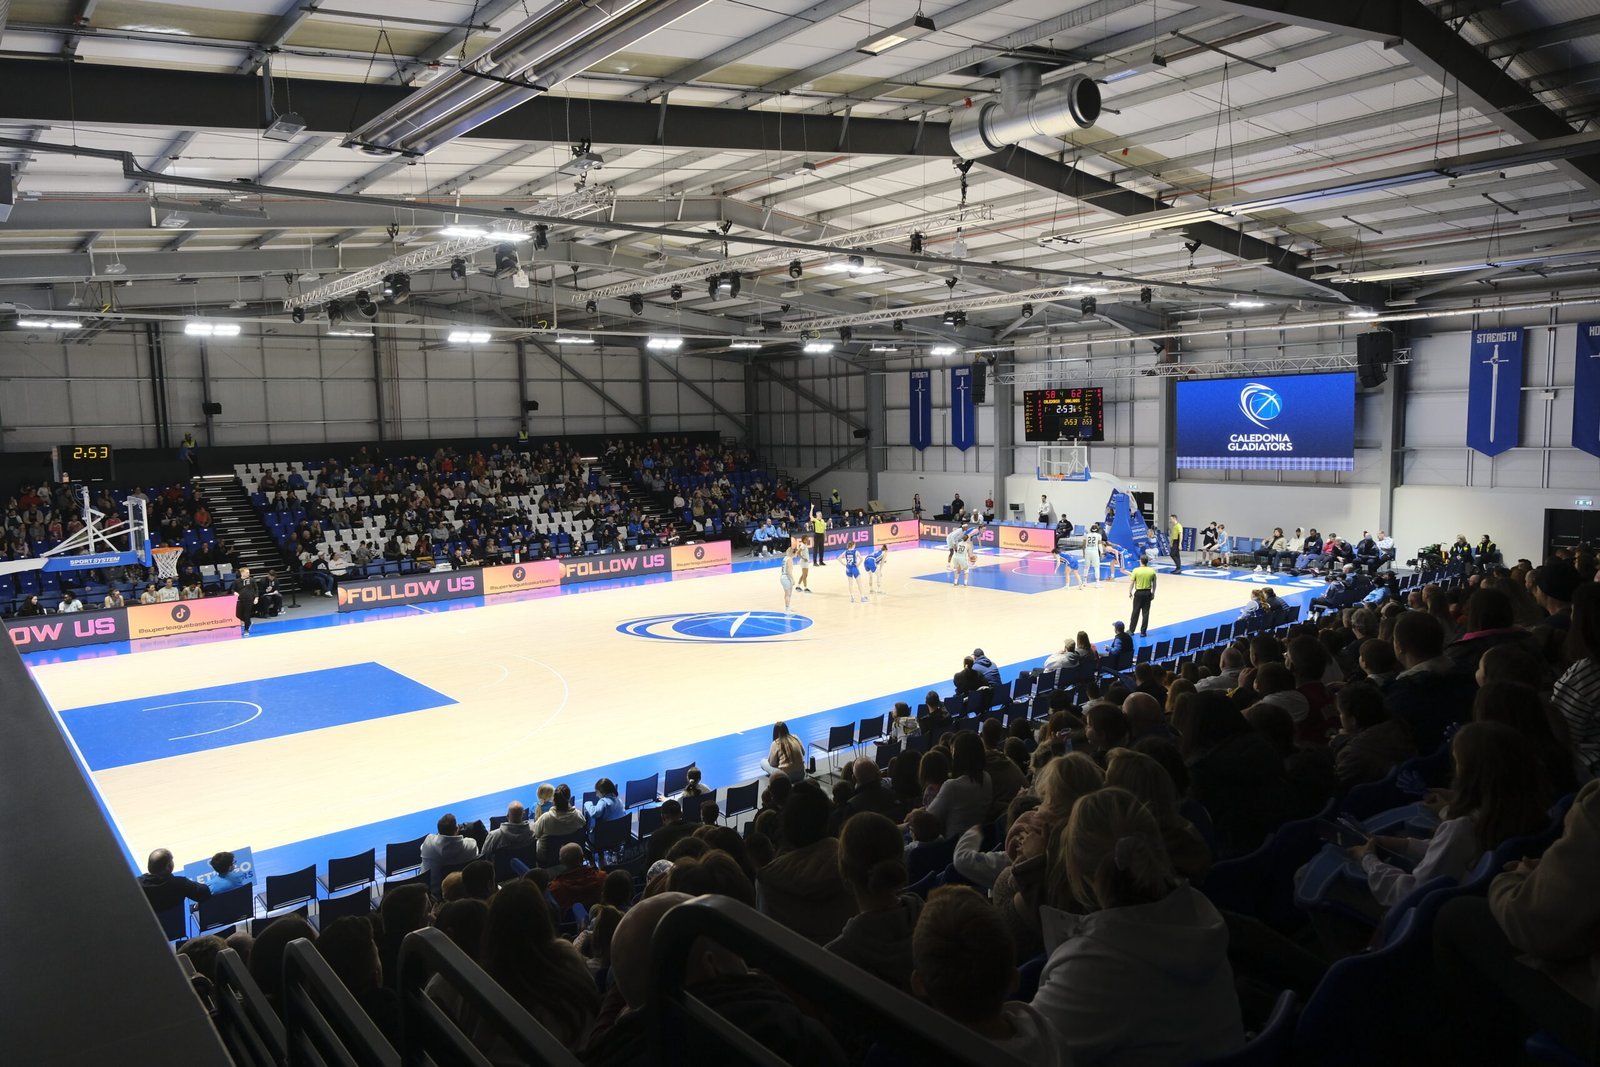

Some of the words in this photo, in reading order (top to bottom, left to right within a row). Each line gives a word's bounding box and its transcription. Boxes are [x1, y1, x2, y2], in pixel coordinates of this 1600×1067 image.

[1476, 331, 1517, 343] STRENGTH
[1045, 391, 1056, 399] 58
[1071, 389, 1082, 398] 62
[1230, 433, 1290, 442] CALEDONIA
[73, 446, 108, 459] 2:53
[1227, 442, 1293, 451] GLADIATORS
[852, 530, 869, 543] US
[1087, 536, 1096, 544] 22
[566, 557, 638, 578] FOLLOW
[643, 554, 665, 569] US
[347, 580, 440, 604] FOLLOW
[447, 575, 475, 593] US
[74, 617, 115, 638] US
